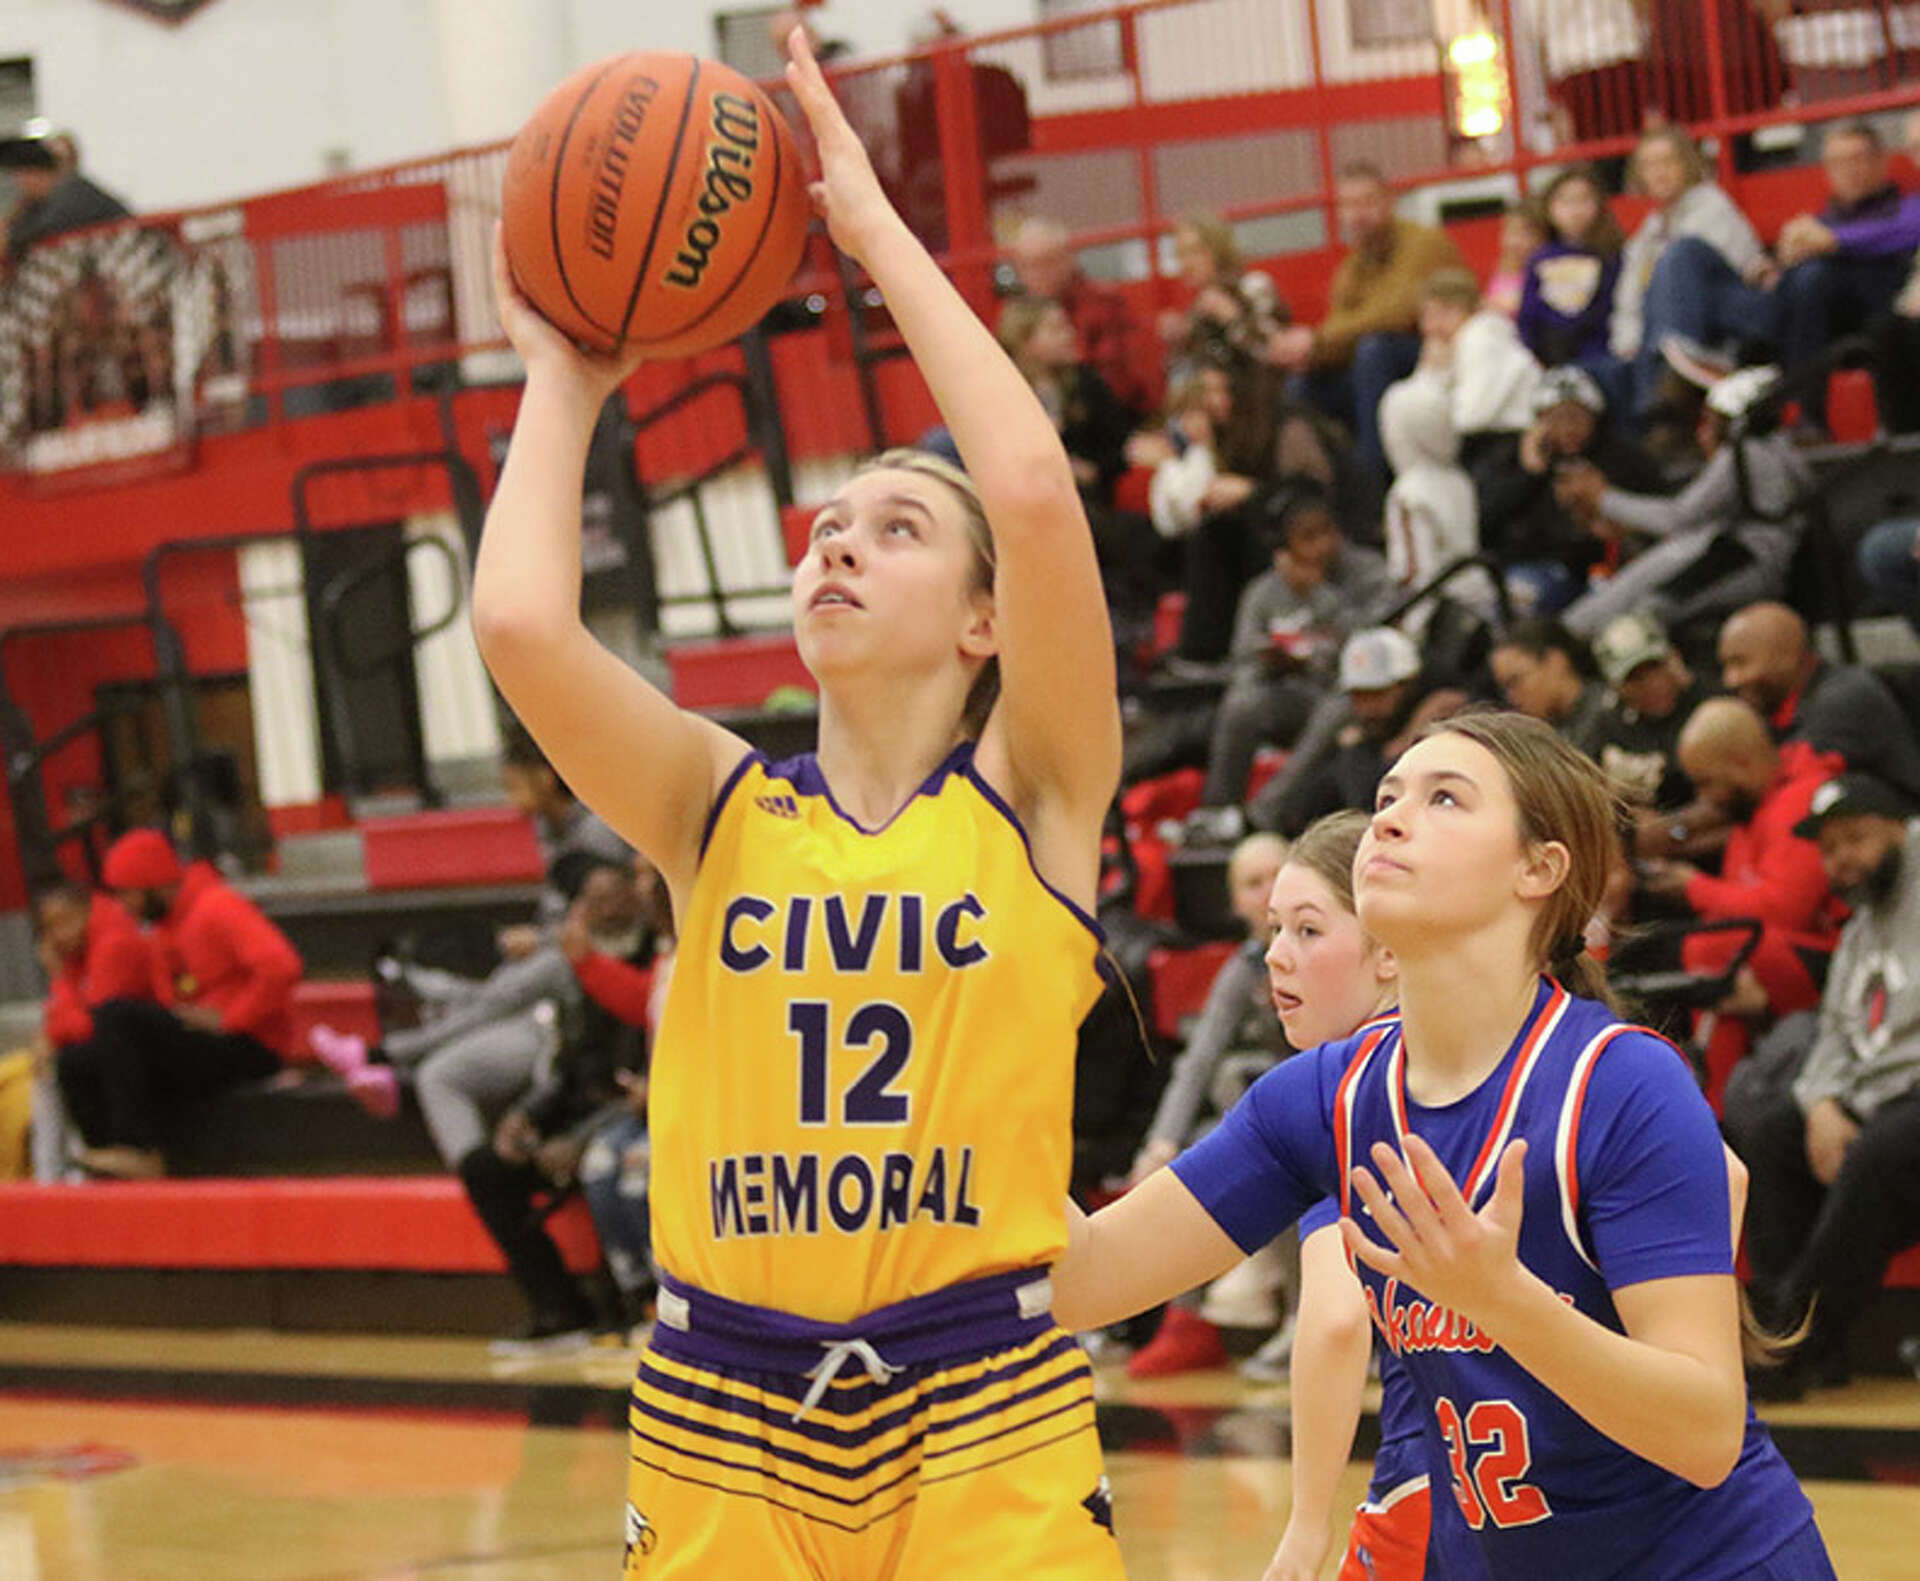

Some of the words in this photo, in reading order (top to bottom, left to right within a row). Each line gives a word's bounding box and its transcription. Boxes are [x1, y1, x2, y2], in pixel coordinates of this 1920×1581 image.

[662, 92, 759, 288] Wilson
[719, 893, 990, 973] CIVIC
[787, 1000, 913, 1127] 12
[710, 1146, 981, 1239] MEMORAL
[1434, 1396, 1553, 1531] 32
